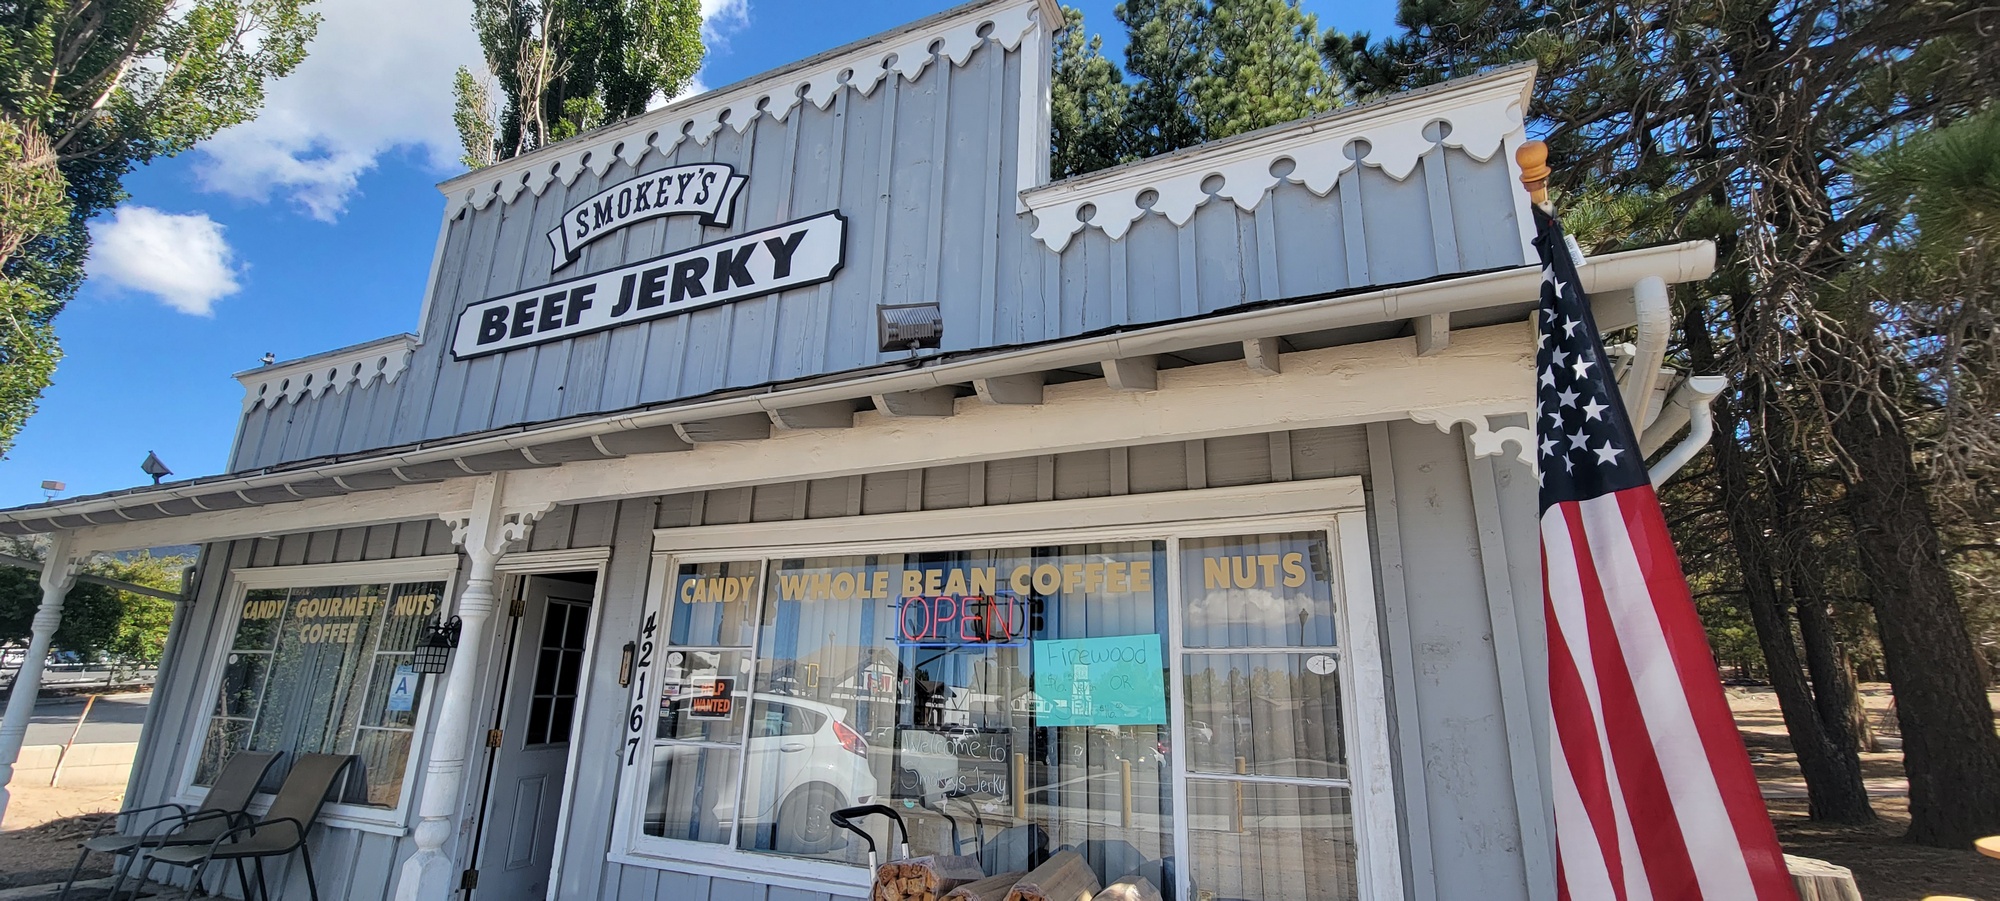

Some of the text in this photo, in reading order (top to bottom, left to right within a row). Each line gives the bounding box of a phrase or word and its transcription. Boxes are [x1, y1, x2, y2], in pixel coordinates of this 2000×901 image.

[576, 168, 716, 239] SMOKEY'S
[476, 228, 809, 346] BEEF JERKY
[779, 561, 1151, 601] WHOLE BEAN COFFEE
[1203, 552, 1306, 589] NUTS
[680, 576, 756, 604] CANDY
[243, 600, 285, 619] CANDY
[295, 596, 378, 618] GOURMET
[394, 594, 435, 616] NUTS
[901, 596, 1014, 641] OPEN
[300, 623, 358, 644] COFFEE
[1046, 640, 1146, 666] Firewood
[395, 676, 407, 695] A
[627, 611, 657, 766] 42167
[1109, 674, 1134, 690] OR
[693, 698, 730, 713] WANTED
[904, 732, 1006, 762] Welcome to
[971, 766, 1007, 803] Jerky
